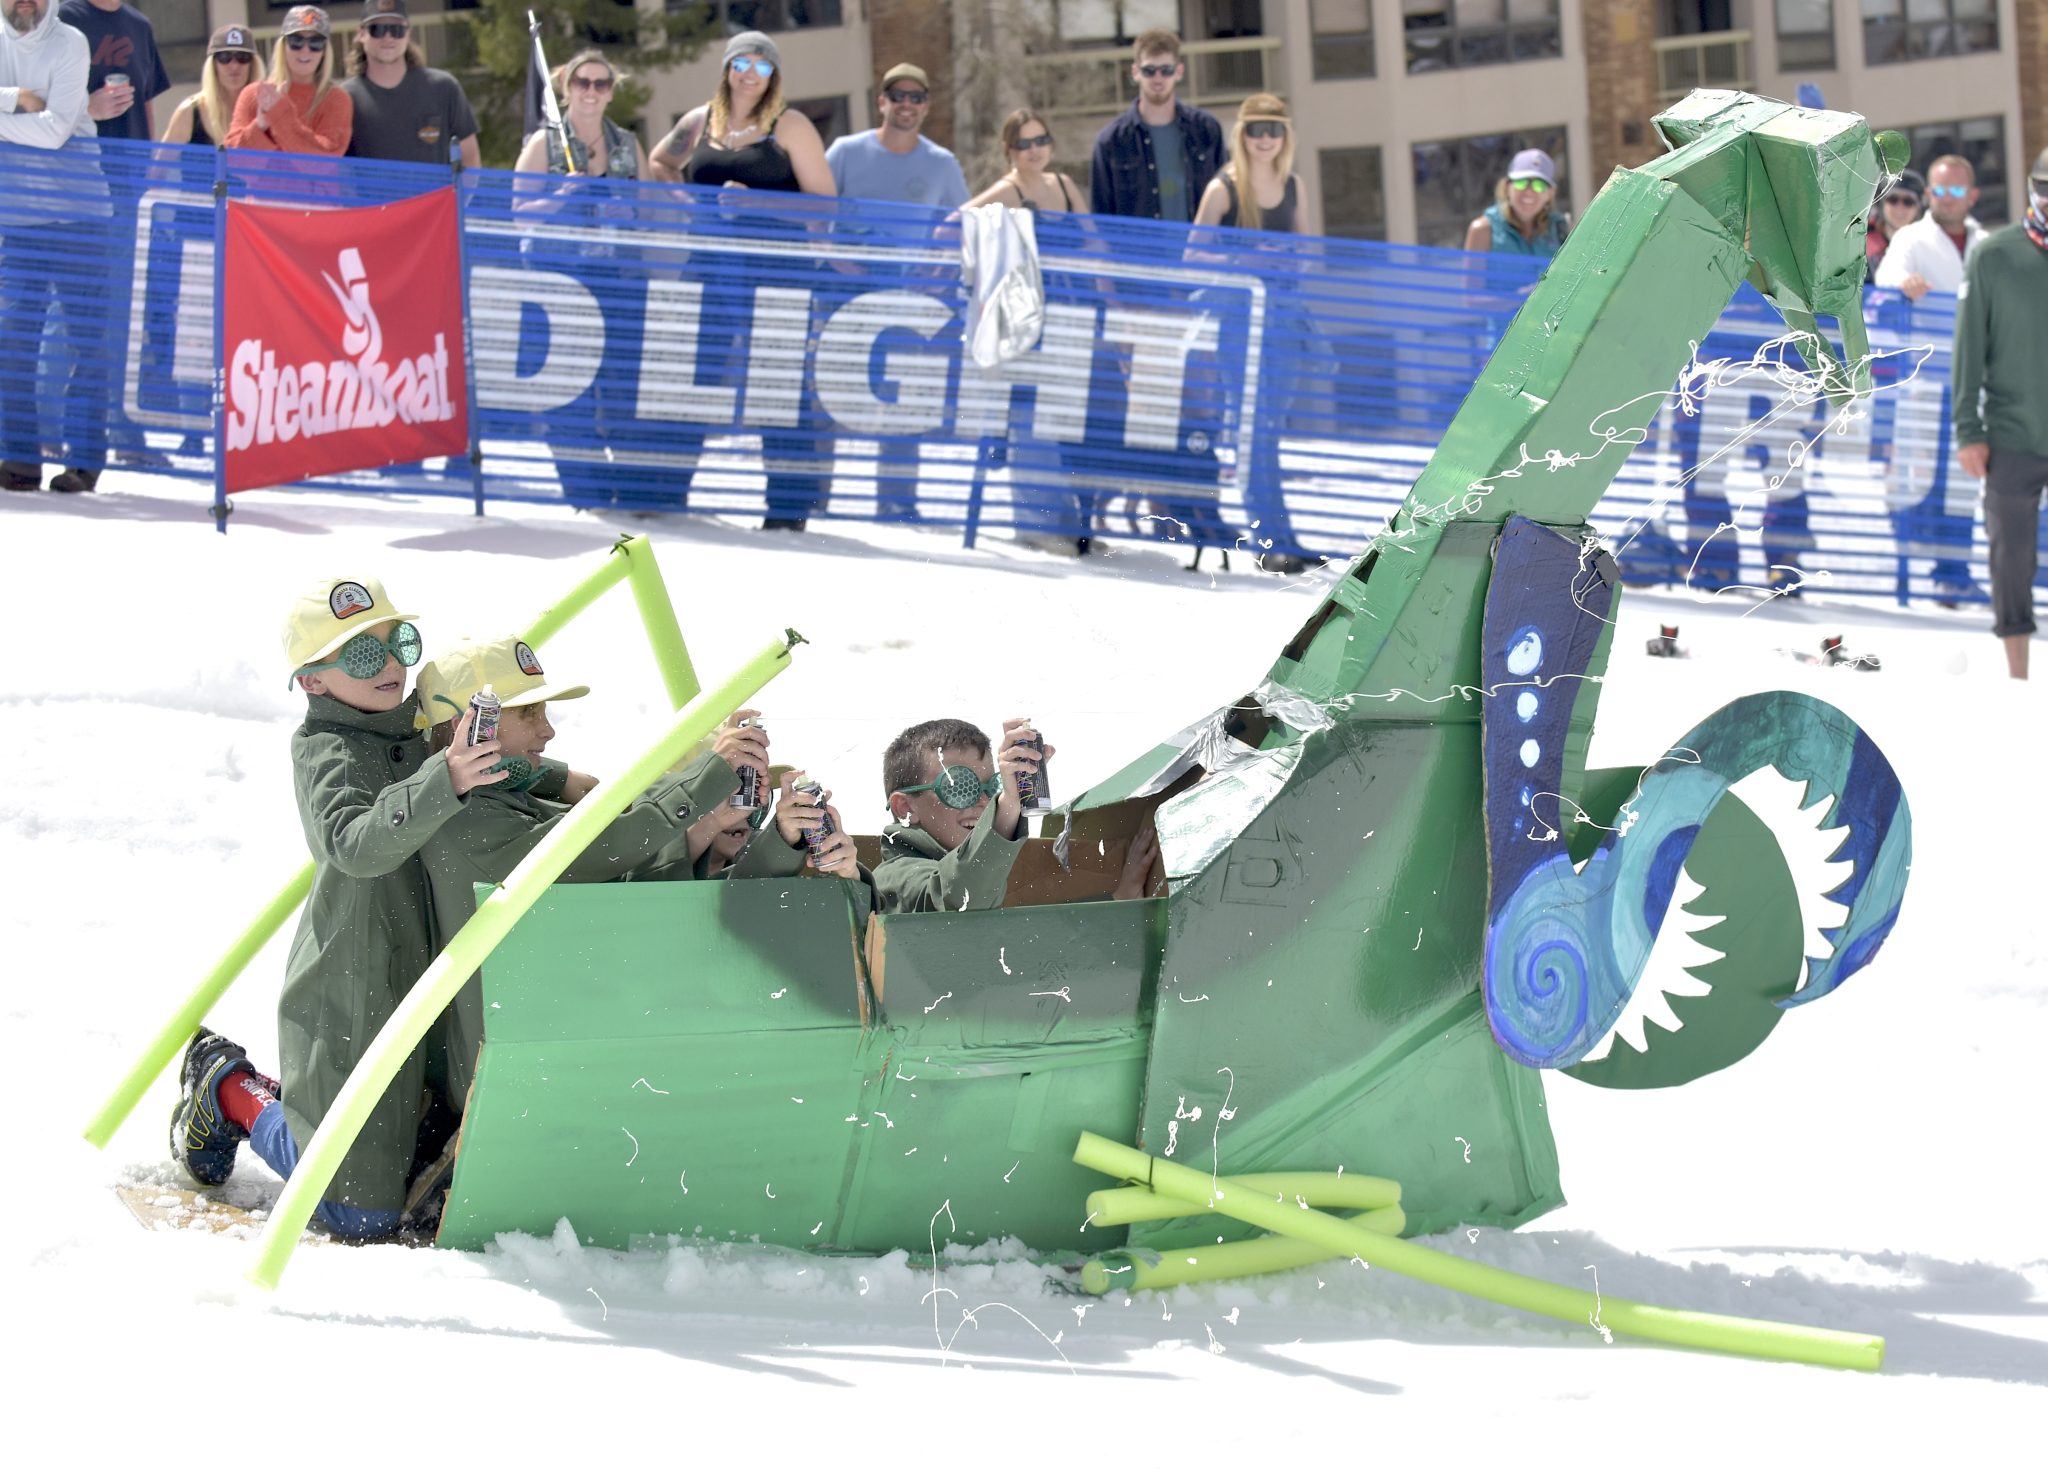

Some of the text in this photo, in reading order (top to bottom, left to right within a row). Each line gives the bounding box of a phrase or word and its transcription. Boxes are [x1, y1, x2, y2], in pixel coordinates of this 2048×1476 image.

[227, 332, 455, 451] Steamboat
[635, 279, 1219, 451] LIGHT
[1694, 362, 1984, 517] BU
